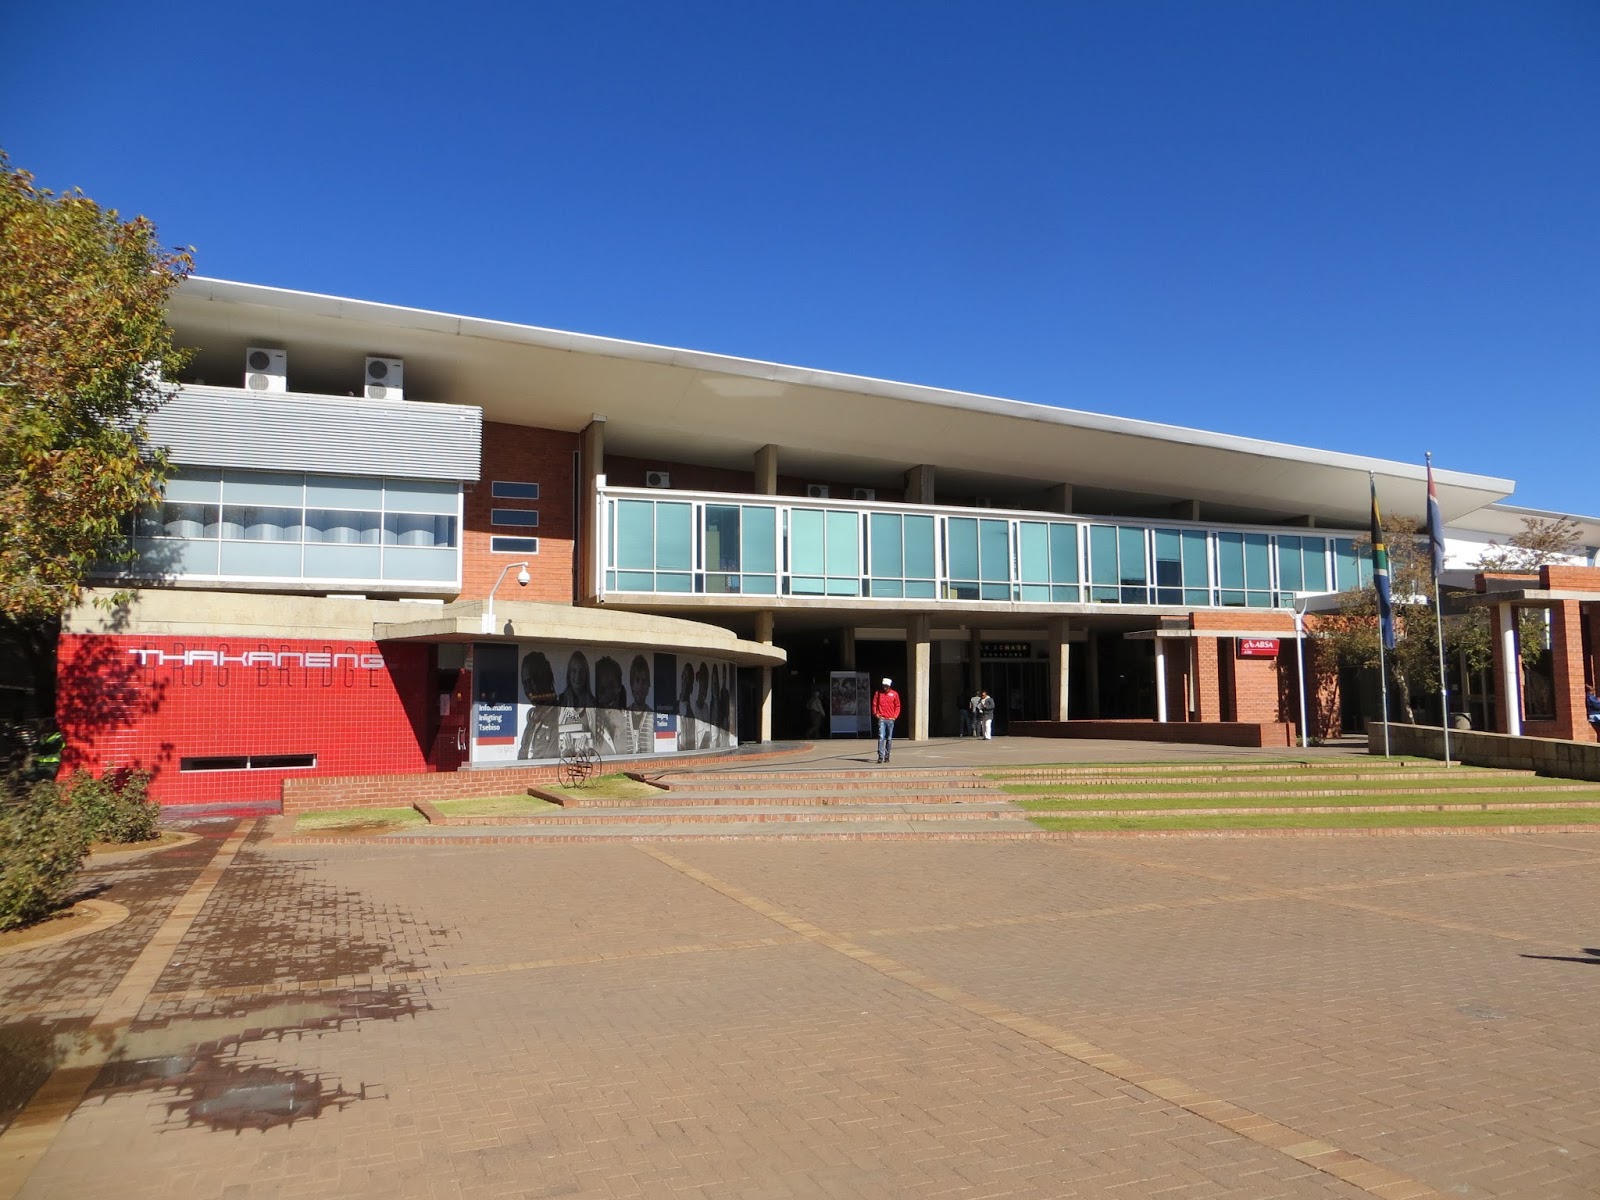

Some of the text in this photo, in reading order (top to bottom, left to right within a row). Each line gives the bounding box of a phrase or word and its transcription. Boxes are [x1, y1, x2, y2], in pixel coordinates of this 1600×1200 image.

[128, 649, 385, 668] THAKANENG
[142, 642, 379, 688] BRUG BRIDGE
[478, 704, 513, 712] Information
[478, 714, 503, 723] Inligting
[478, 723, 501, 731] Tsebiso
